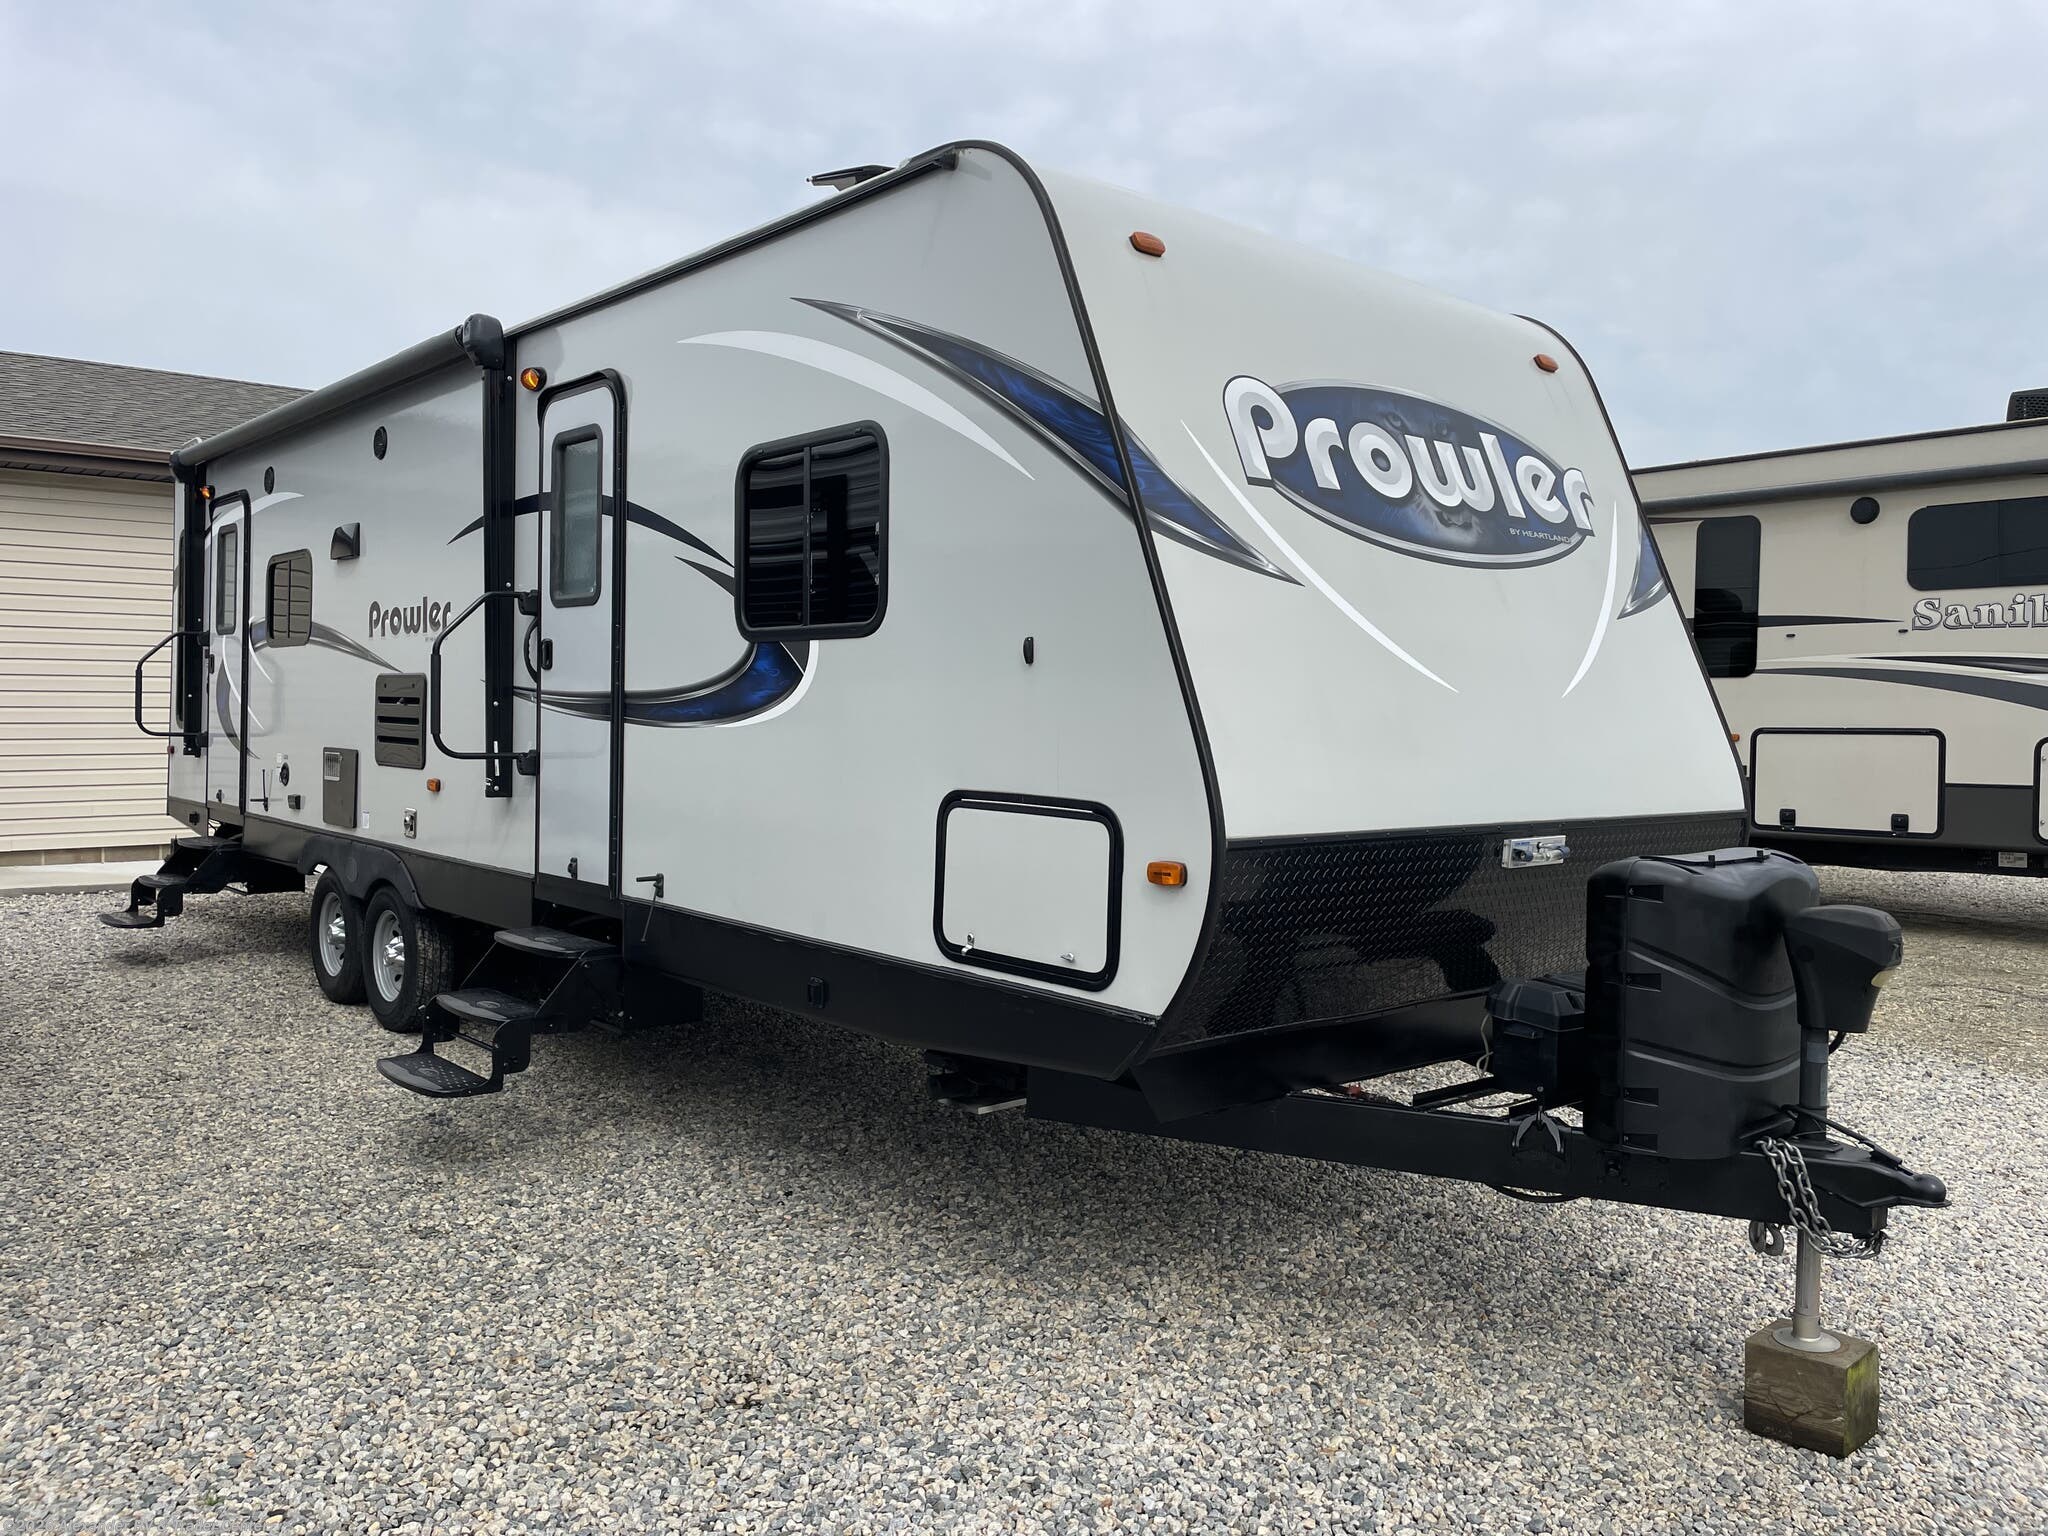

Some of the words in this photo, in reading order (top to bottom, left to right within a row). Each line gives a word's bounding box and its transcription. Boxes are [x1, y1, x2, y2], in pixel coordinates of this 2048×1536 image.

[1223, 375, 1596, 537] Prowler
[1509, 527, 1521, 536] BY
[1521, 530, 1571, 544] HEARTLAND
[368, 595, 451, 638] Prowler
